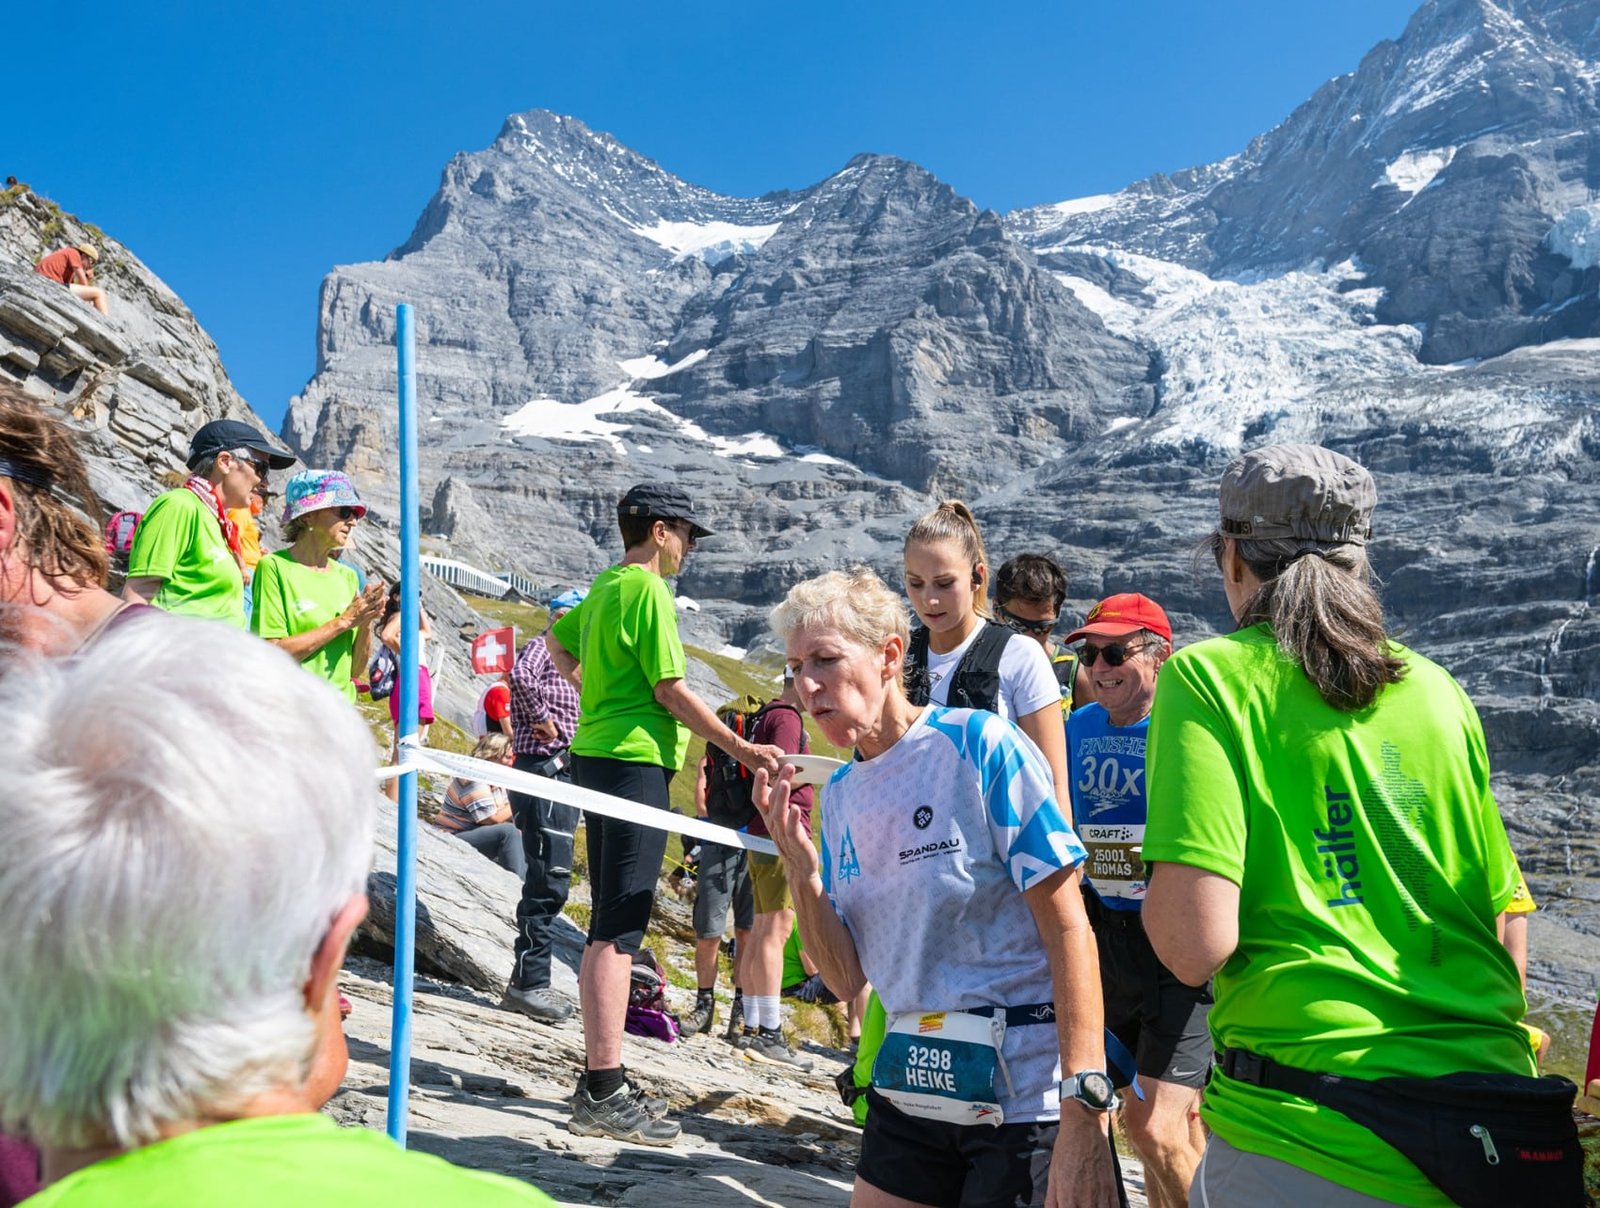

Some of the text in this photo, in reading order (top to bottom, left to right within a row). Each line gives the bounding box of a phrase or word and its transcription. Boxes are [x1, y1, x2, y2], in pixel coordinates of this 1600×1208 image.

[1077, 736, 1147, 758] FINISHE
[1089, 829, 1120, 839] CRAFT
[899, 838, 960, 860] SPANDAU
[1094, 848, 1126, 862] 25001
[1312, 785, 1364, 908] hälfer
[1093, 862, 1132, 876] THOMAS
[907, 1045, 952, 1071] 3298
[905, 1067, 957, 1092] HEIKE
